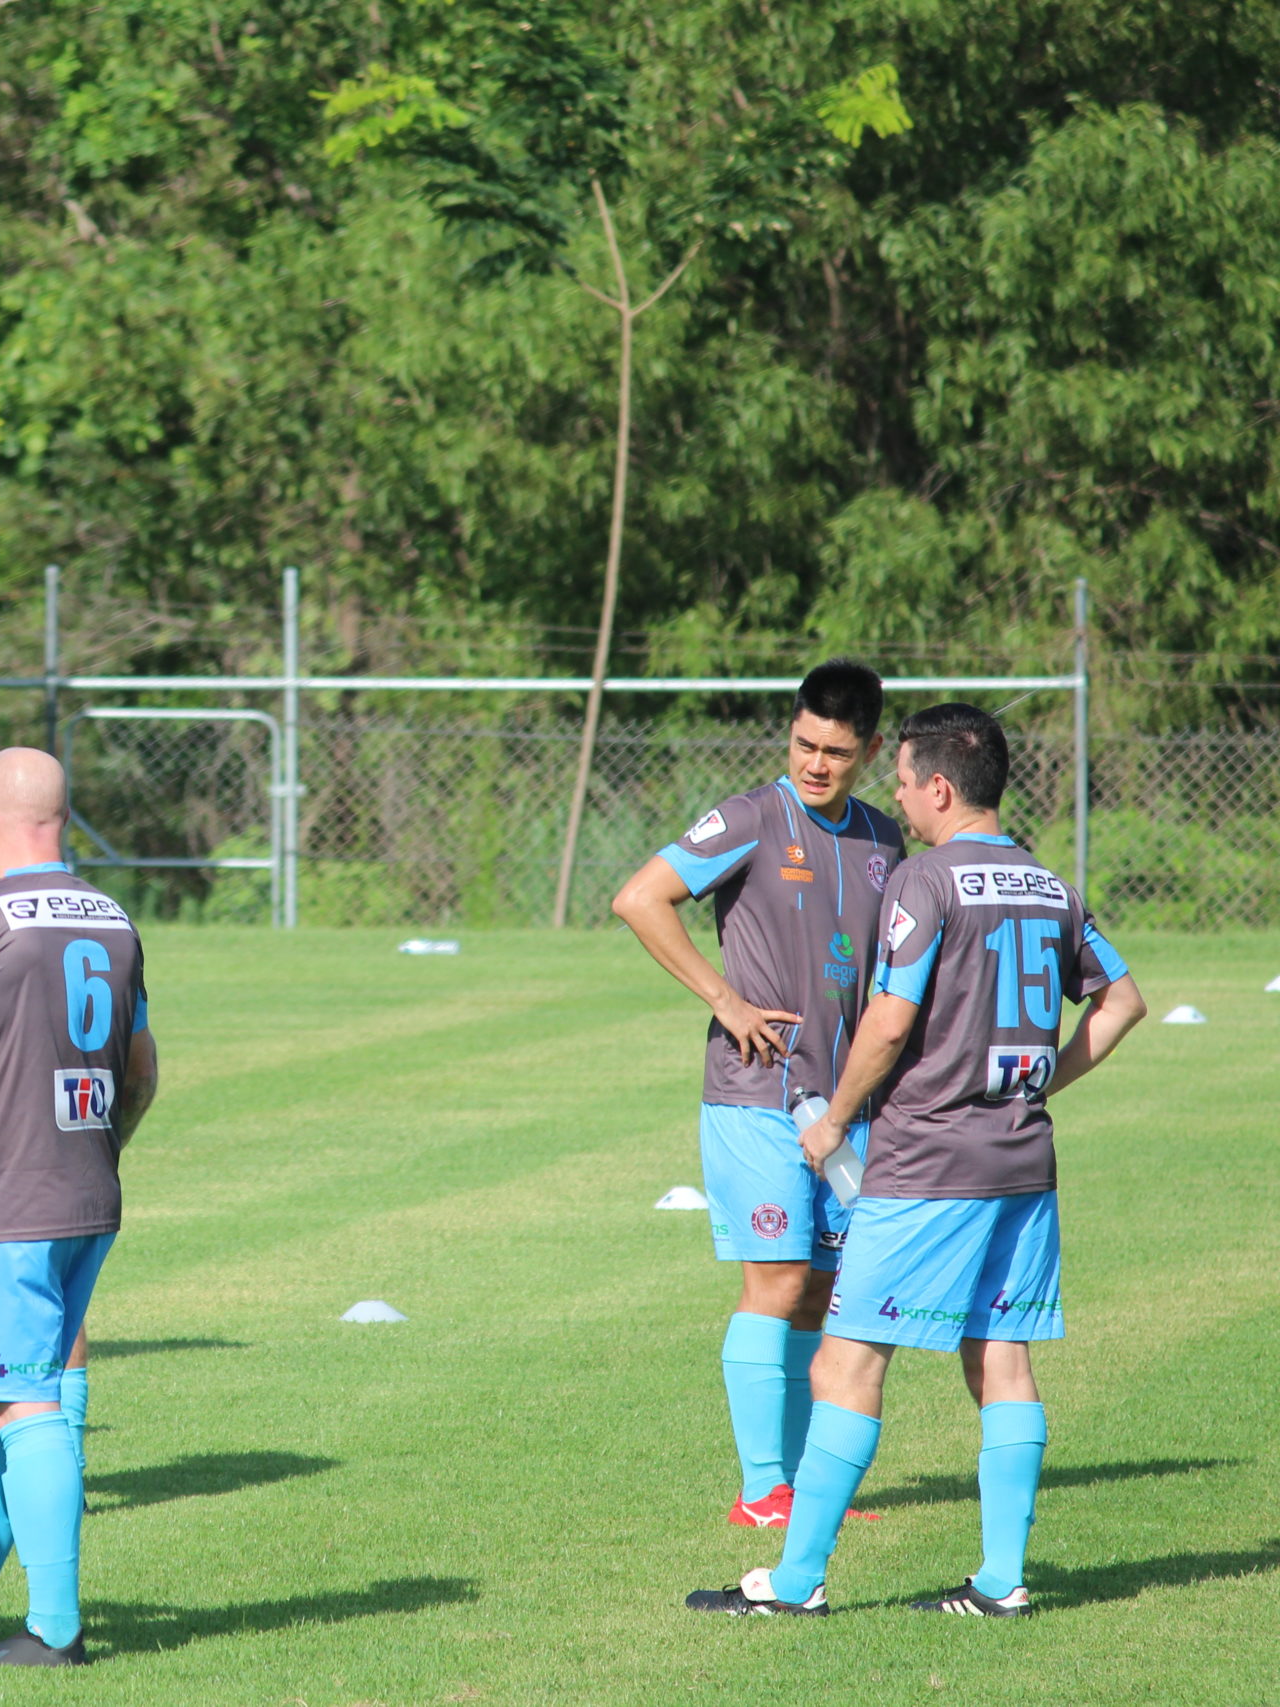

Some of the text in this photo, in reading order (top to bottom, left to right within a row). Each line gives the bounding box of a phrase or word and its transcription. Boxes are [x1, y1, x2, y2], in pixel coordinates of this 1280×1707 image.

[992, 872, 1061, 891] espec
[63, 939, 112, 1052] 6
[823, 963, 857, 987] regis
[985, 918, 1061, 1030] 15
